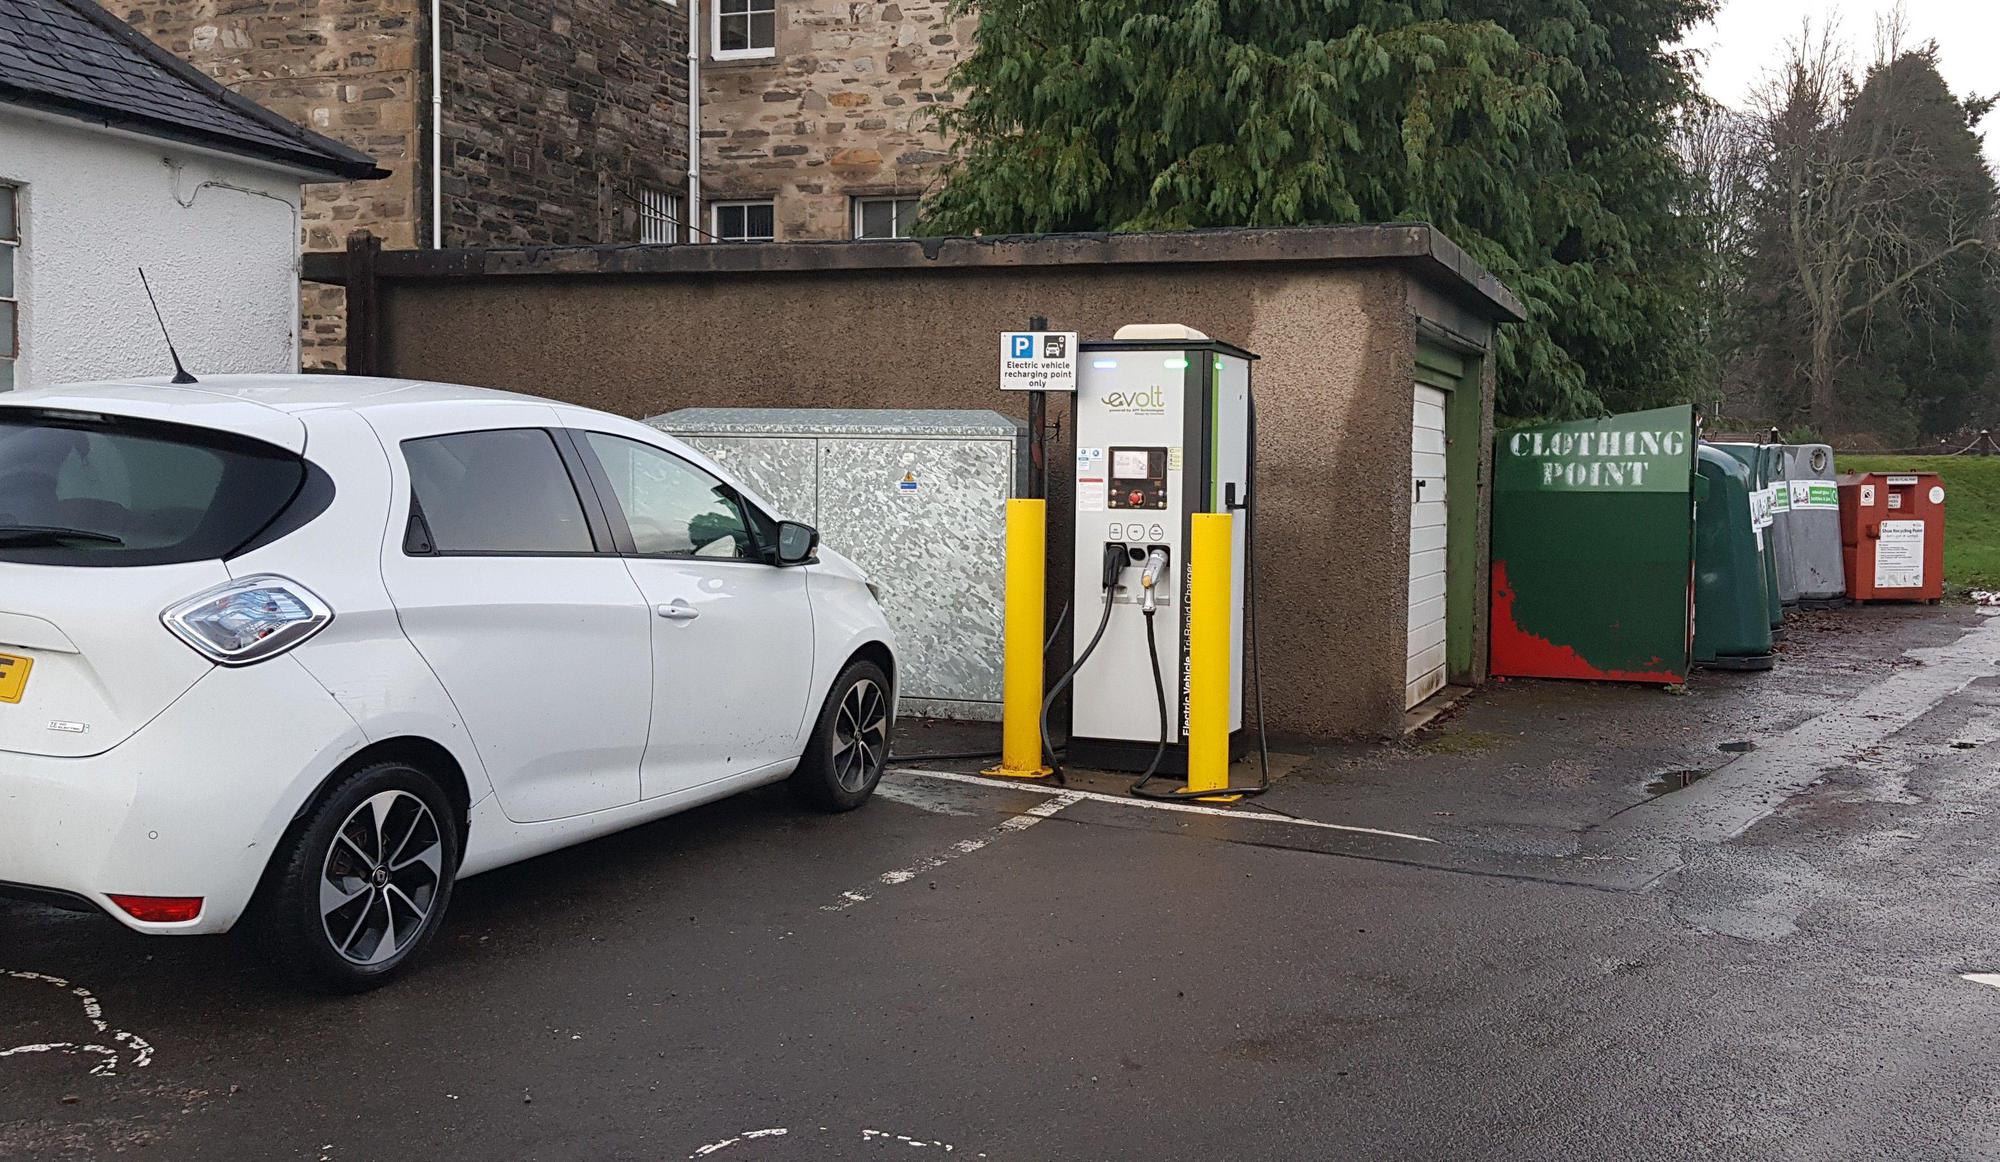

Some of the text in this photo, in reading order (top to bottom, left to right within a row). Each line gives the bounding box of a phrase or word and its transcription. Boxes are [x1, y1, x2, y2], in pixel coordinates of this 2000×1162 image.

[1015, 337, 1030, 356] P
[1004, 370, 1072, 379] recharging point
[1006, 361, 1070, 369] Electric vehicle
[1028, 380, 1047, 388] only
[1101, 385, 1165, 408] evolt
[1510, 431, 1684, 456] CLOTHING
[1543, 462, 1648, 486] POINT
